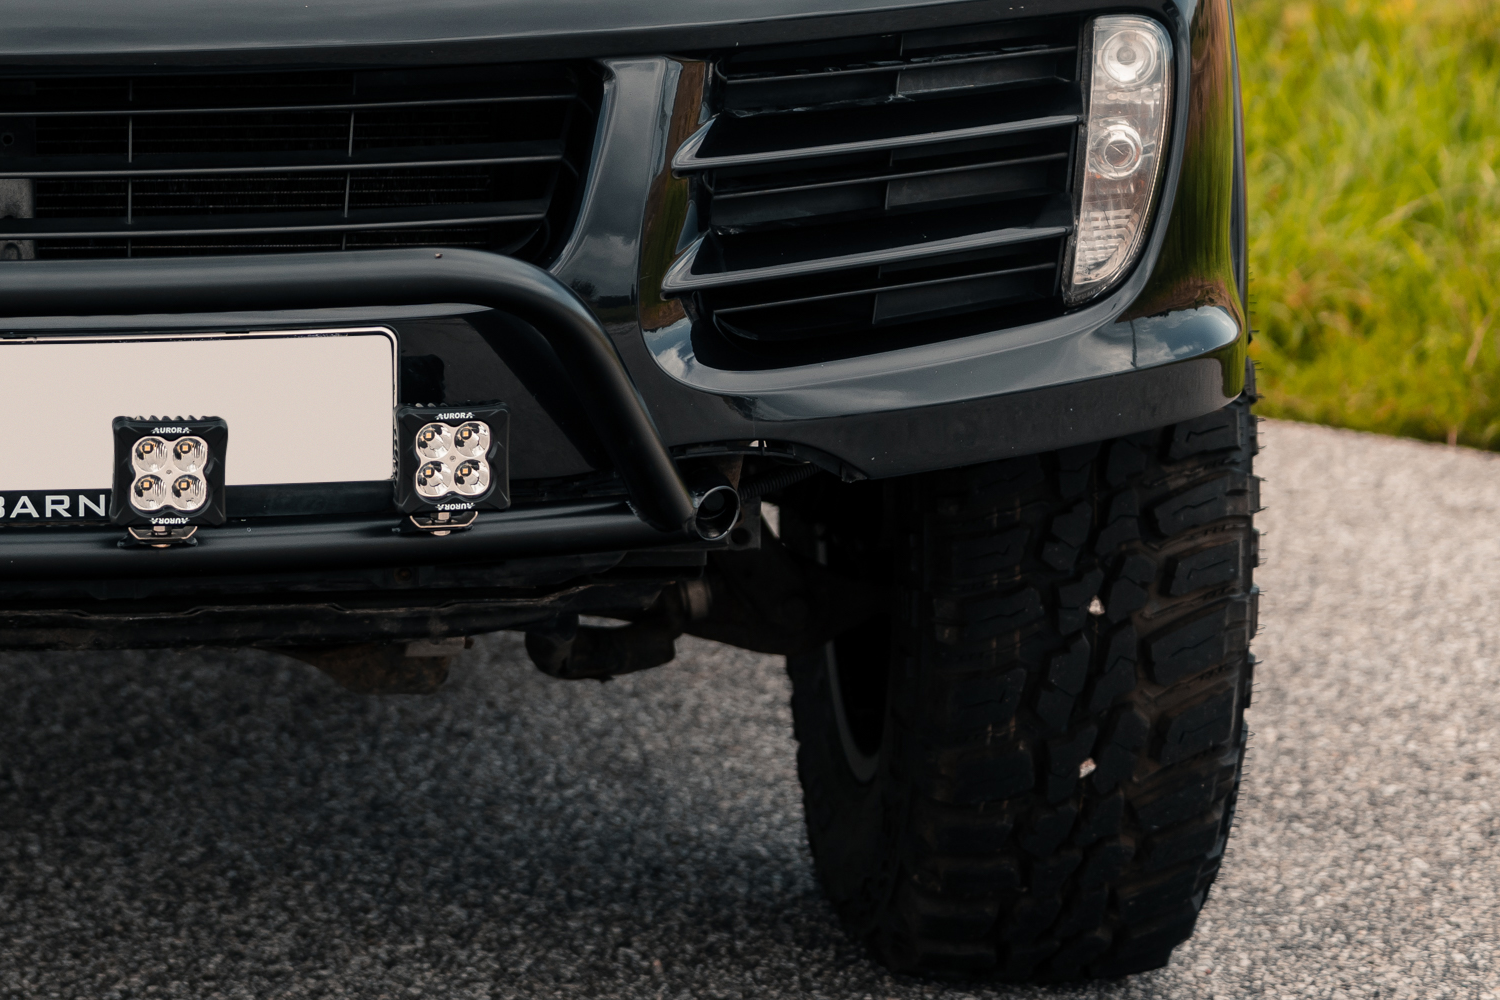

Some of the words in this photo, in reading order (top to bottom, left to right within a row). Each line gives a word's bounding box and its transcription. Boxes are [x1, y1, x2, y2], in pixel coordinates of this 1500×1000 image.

[434, 412, 475, 420] AURORA
[151, 426, 192, 434] AURORA
[434, 502, 475, 511] AURORA
[149, 517, 190, 525] AURORA
